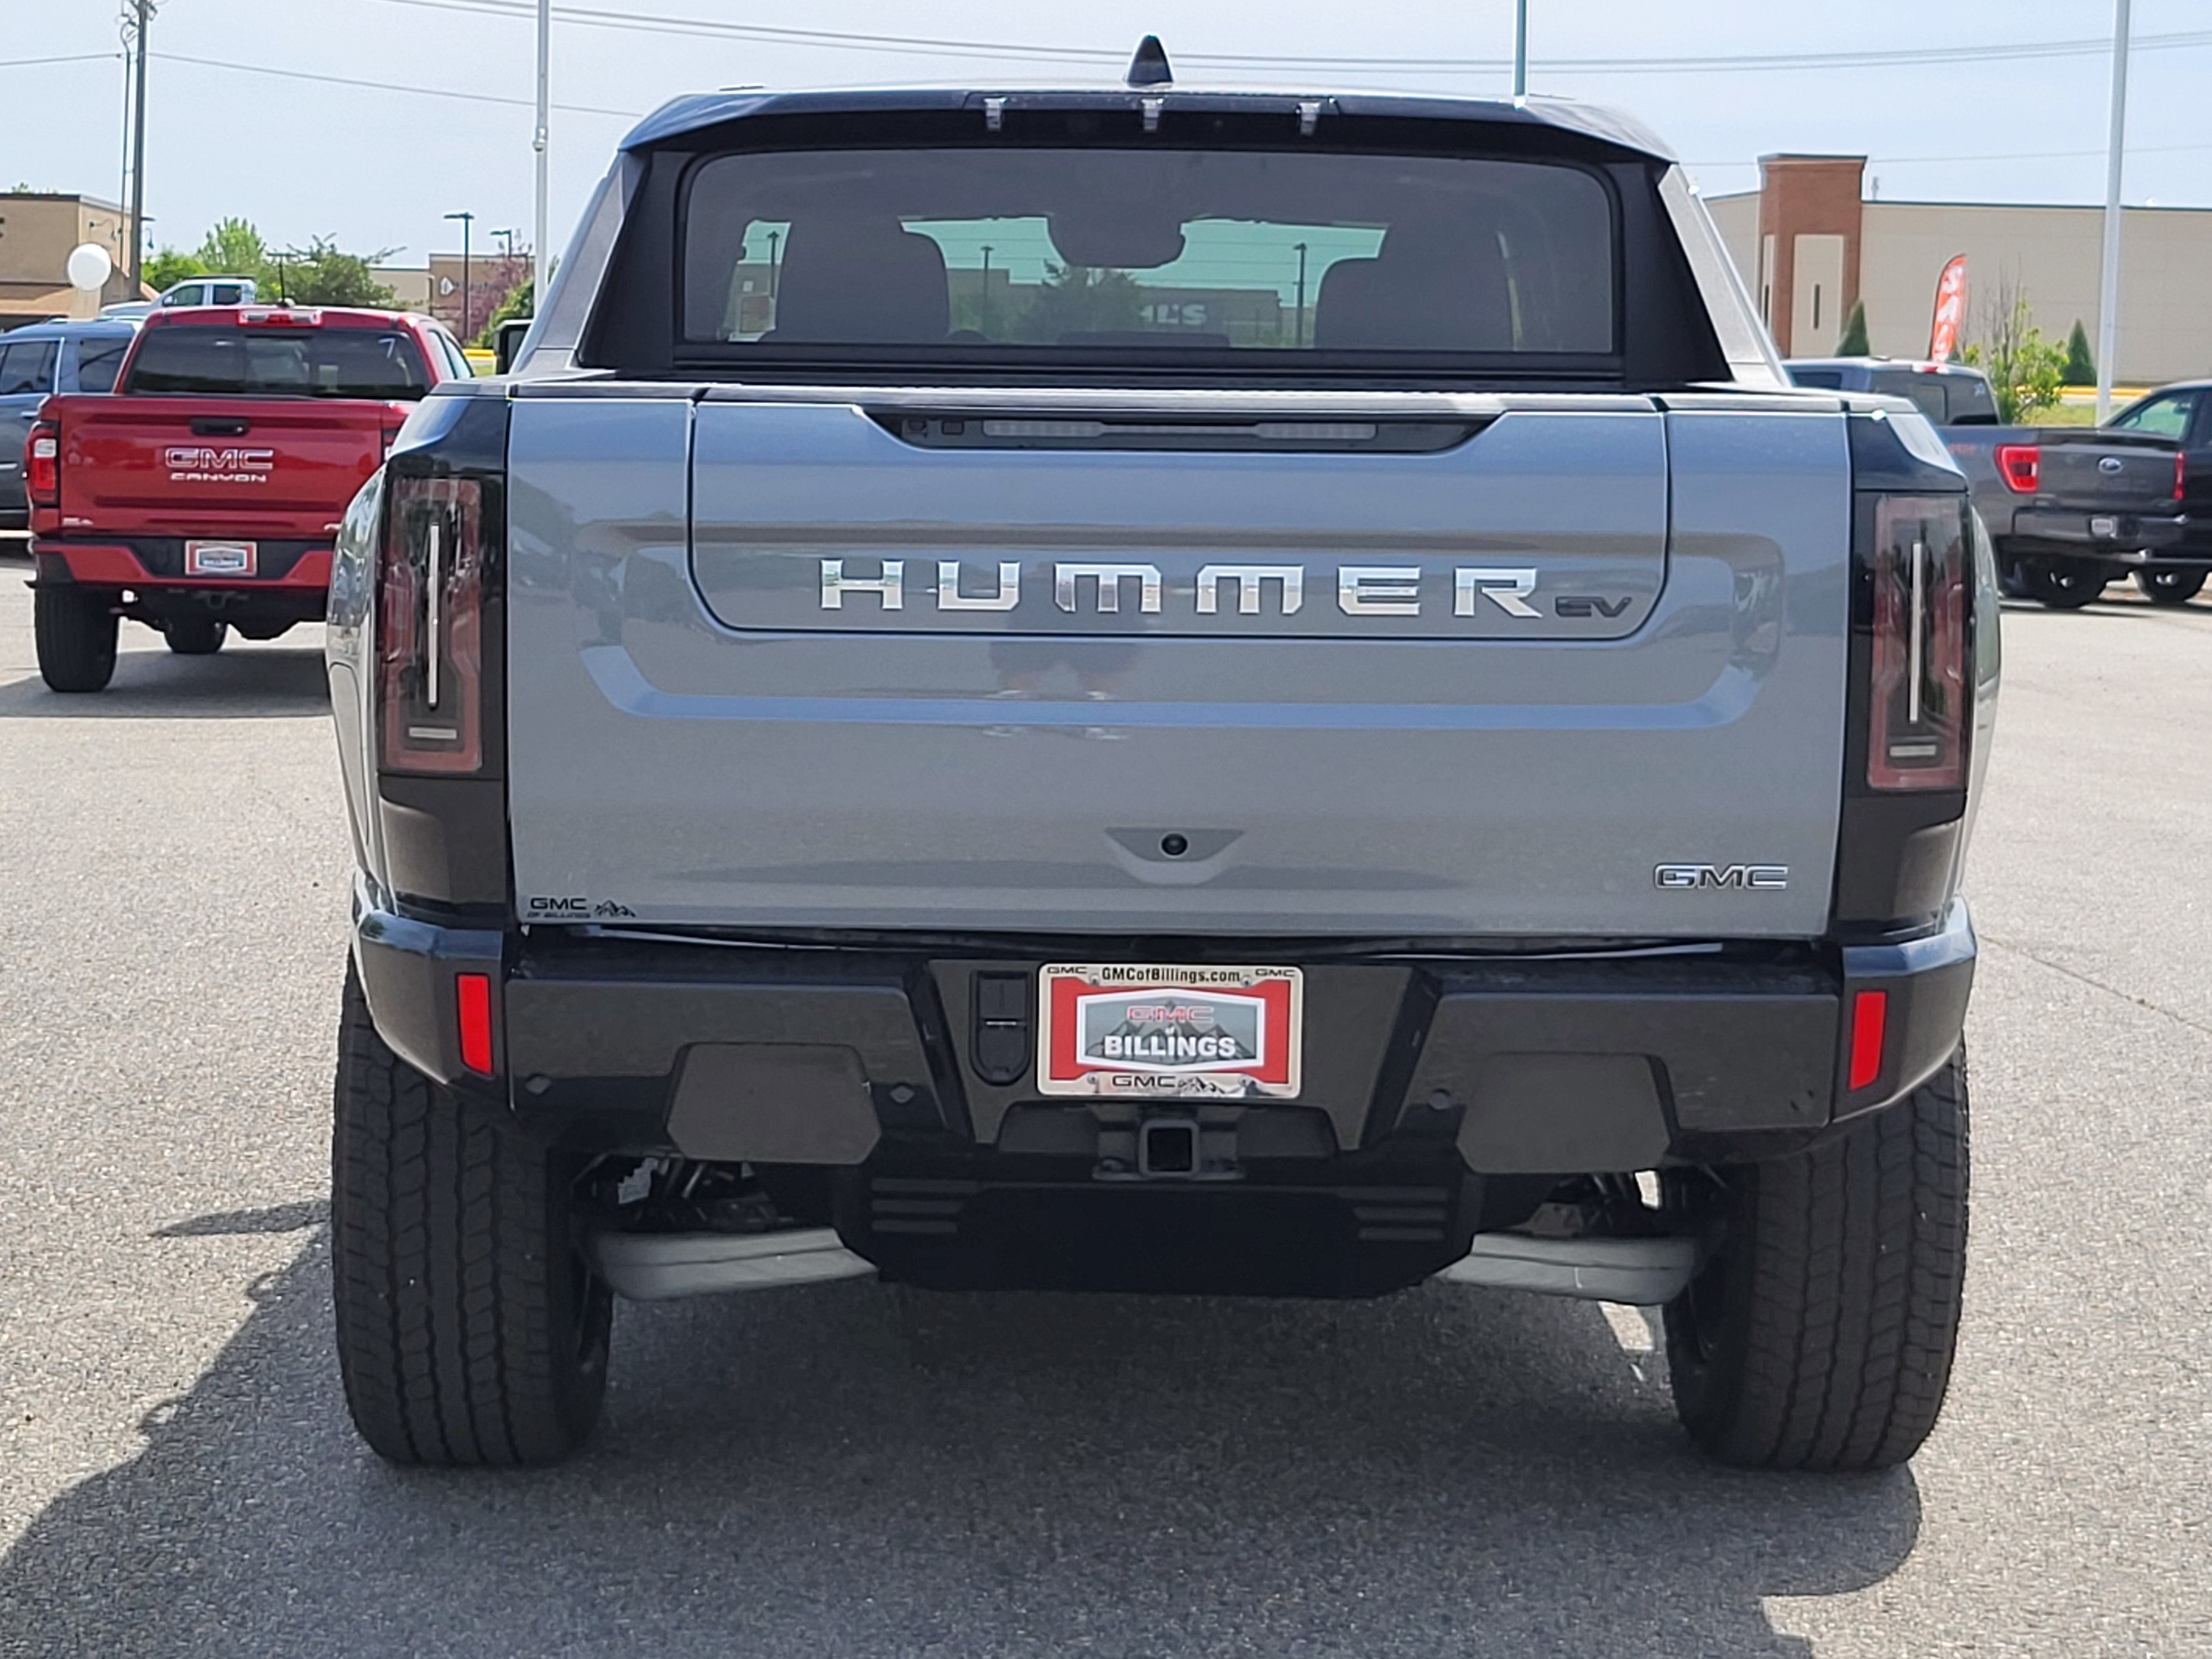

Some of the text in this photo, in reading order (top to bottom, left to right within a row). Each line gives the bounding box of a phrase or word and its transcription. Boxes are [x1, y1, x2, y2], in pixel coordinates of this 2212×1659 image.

[165, 447, 274, 470] GMC
[170, 472, 267, 482] CANYON
[821, 559, 1632, 618] HUMMER EV
[1654, 863, 1789, 890] GMC
[530, 898, 587, 910] GMC
[1102, 967, 1240, 983] GMCofBillings.com
[1255, 969, 1295, 977] GMC
[1126, 1005, 1214, 1023] GMC
[1104, 1035, 1236, 1057] BILLINGS
[1112, 1075, 1176, 1088] GMC
